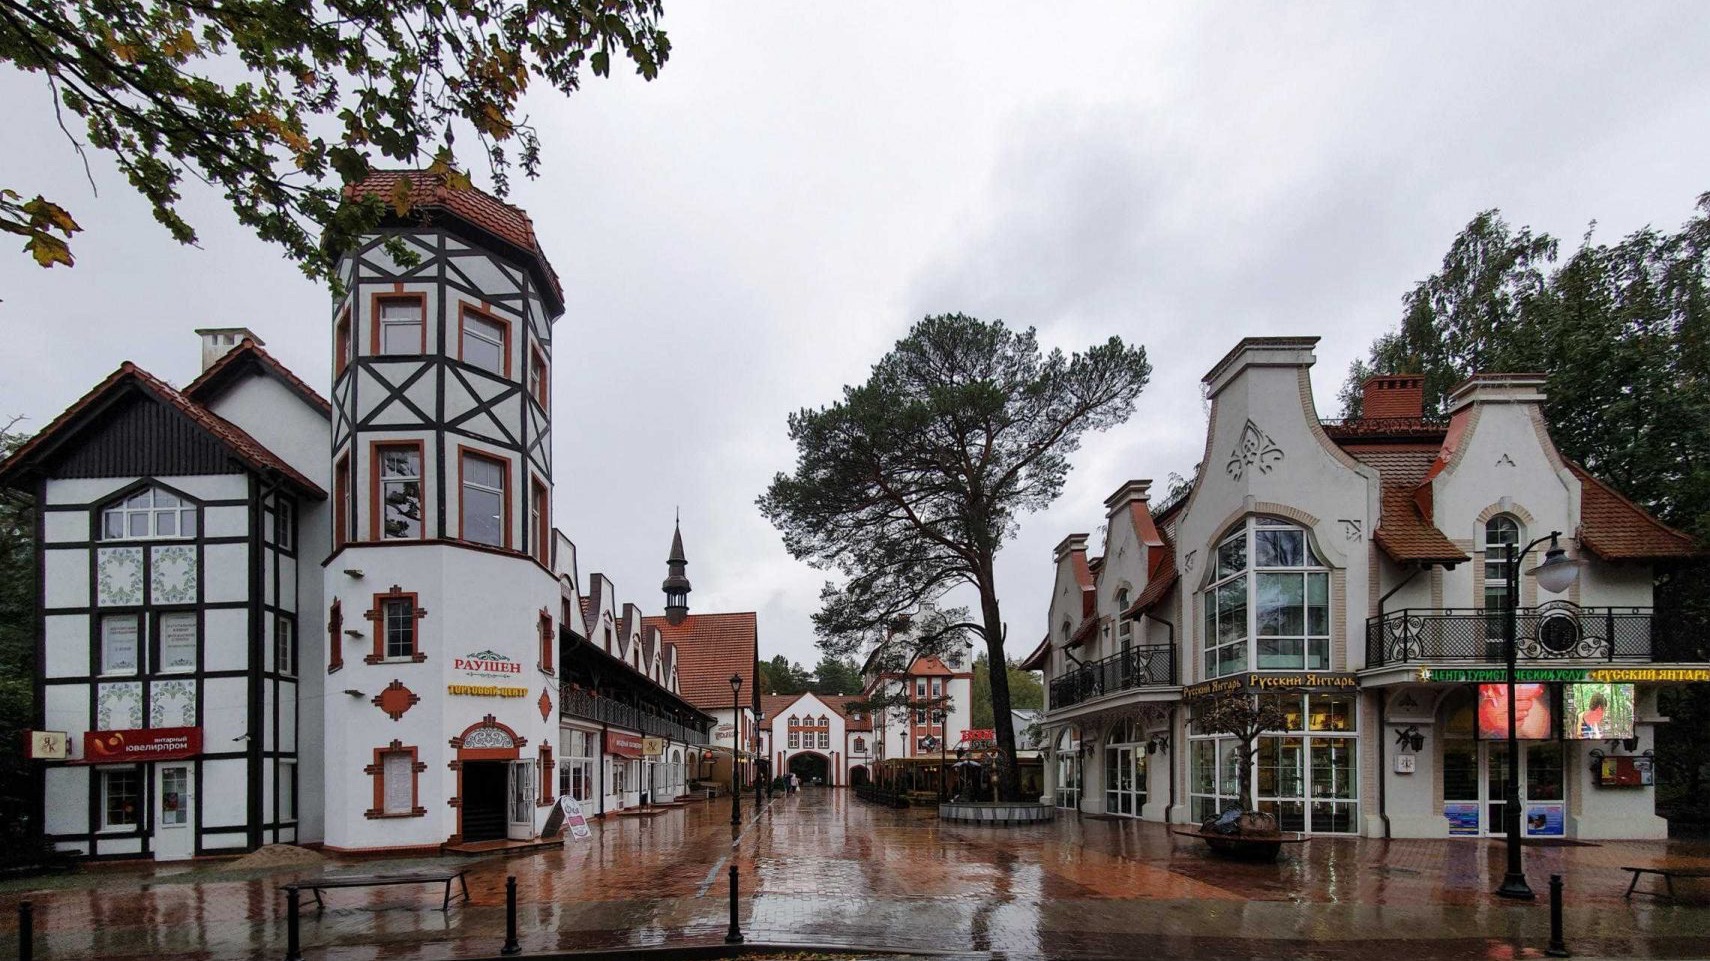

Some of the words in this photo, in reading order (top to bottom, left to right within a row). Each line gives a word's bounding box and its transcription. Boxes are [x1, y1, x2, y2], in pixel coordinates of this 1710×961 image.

[454, 659, 521, 673] РАУШЕН
[1250, 674, 1302, 689] Русский
[1306, 673, 1356, 689] Янтарь
[1431, 669, 1465, 682] ЦЕНТР
[1467, 669, 1555, 682] ТУРИСТЧЕСКИХ
[1659, 669, 1710, 681] ЯНТАРЬ
[448, 684, 497, 697] ТОРГОВЫЙ
[501, 686, 529, 698] ЦЕНТР
[1183, 683, 1211, 699] Русский
[1212, 679, 1242, 692] Янтарь
[154, 735, 188, 743] янтарный
[125, 743, 188, 752] ювелирпром
